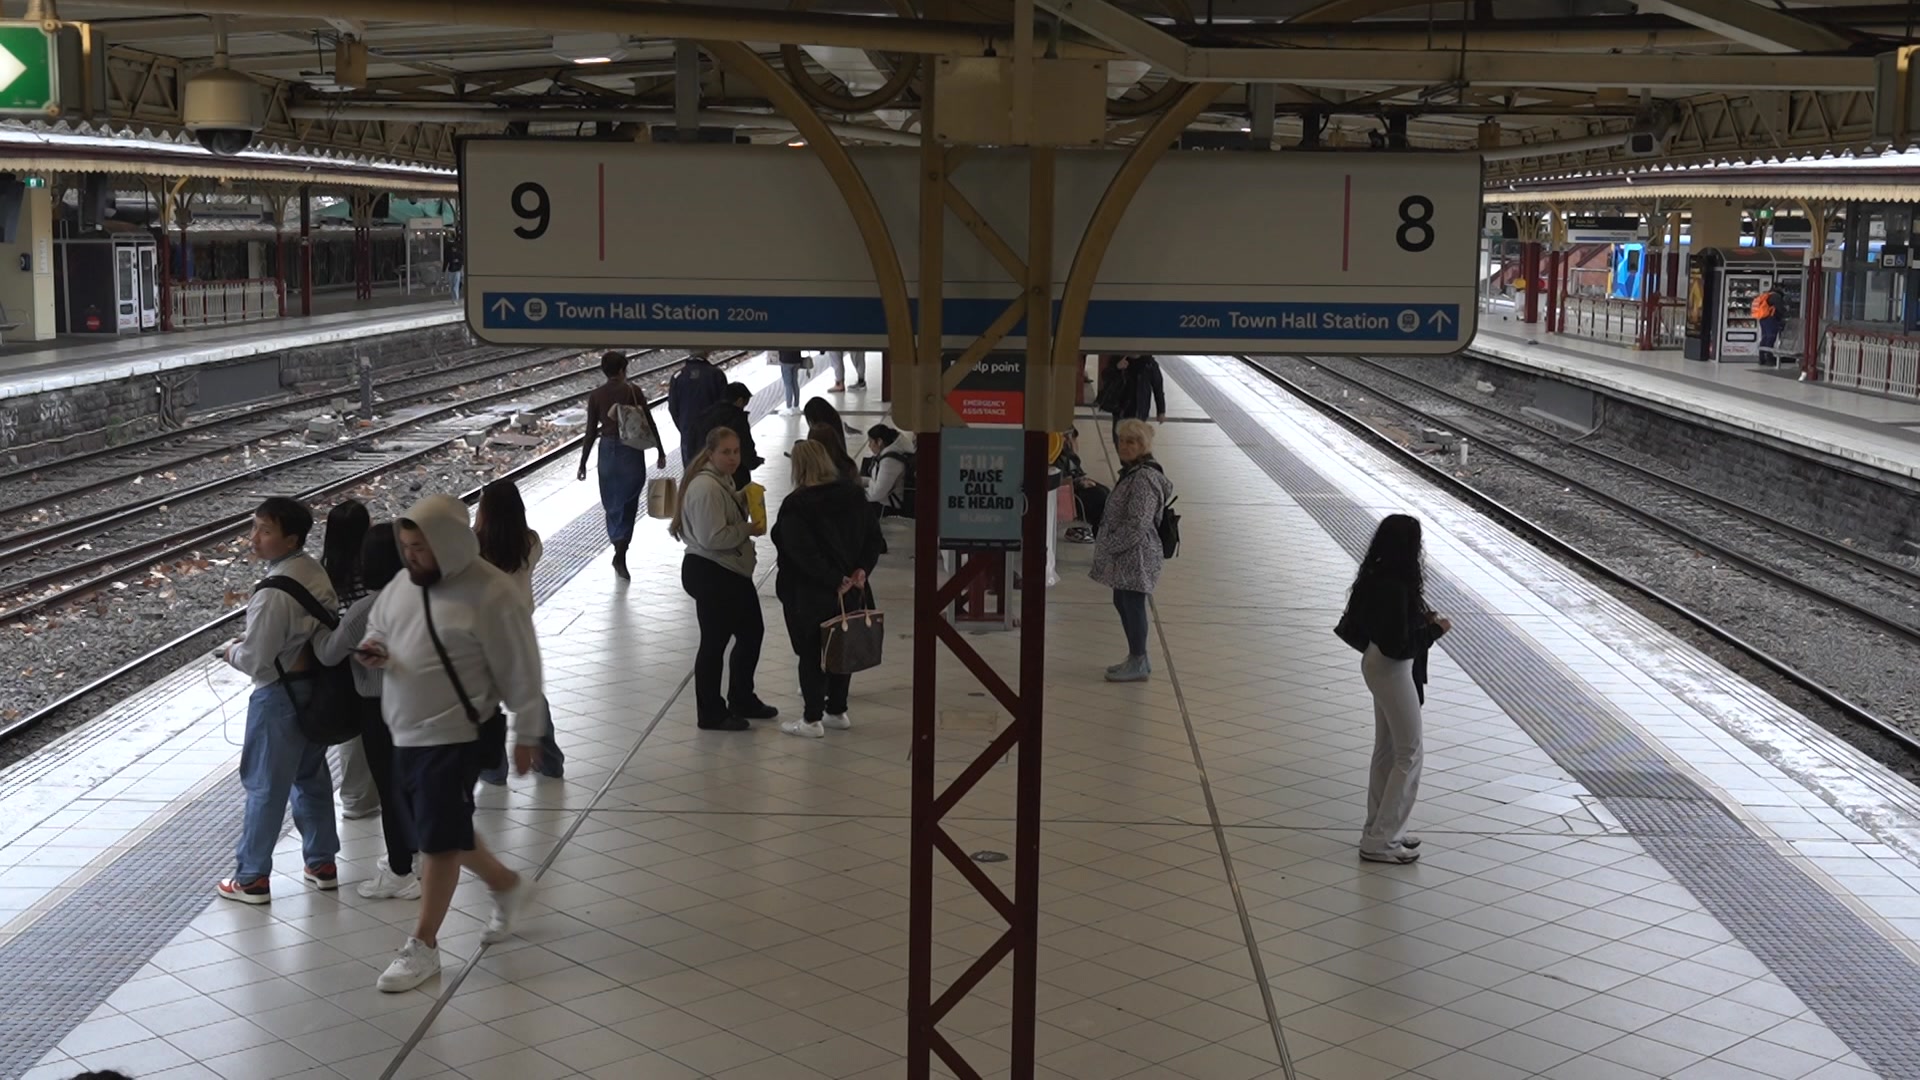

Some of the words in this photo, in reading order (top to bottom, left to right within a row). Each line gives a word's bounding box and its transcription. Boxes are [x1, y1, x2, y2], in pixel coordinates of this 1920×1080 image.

[510, 181, 551, 240] 9
[1395, 194, 1435, 253] 8
[1491, 216, 1498, 226] 6
[555, 301, 605, 319] Town
[610, 302, 647, 319] Hall
[651, 303, 719, 321] Station
[727, 307, 768, 321] 220m
[1179, 314, 1220, 328] 220m
[1228, 311, 1277, 328] Town
[1281, 312, 1318, 329] Hall
[1322, 313, 1389, 329] Station
[991, 362, 1020, 373] point
[963, 399, 1006, 407] EMERGENCY
[962, 408, 1006, 416] ASSISTANCE
[964, 483, 998, 496] CALL
[948, 495, 965, 509] BE
[968, 496, 1014, 510] HEARD
